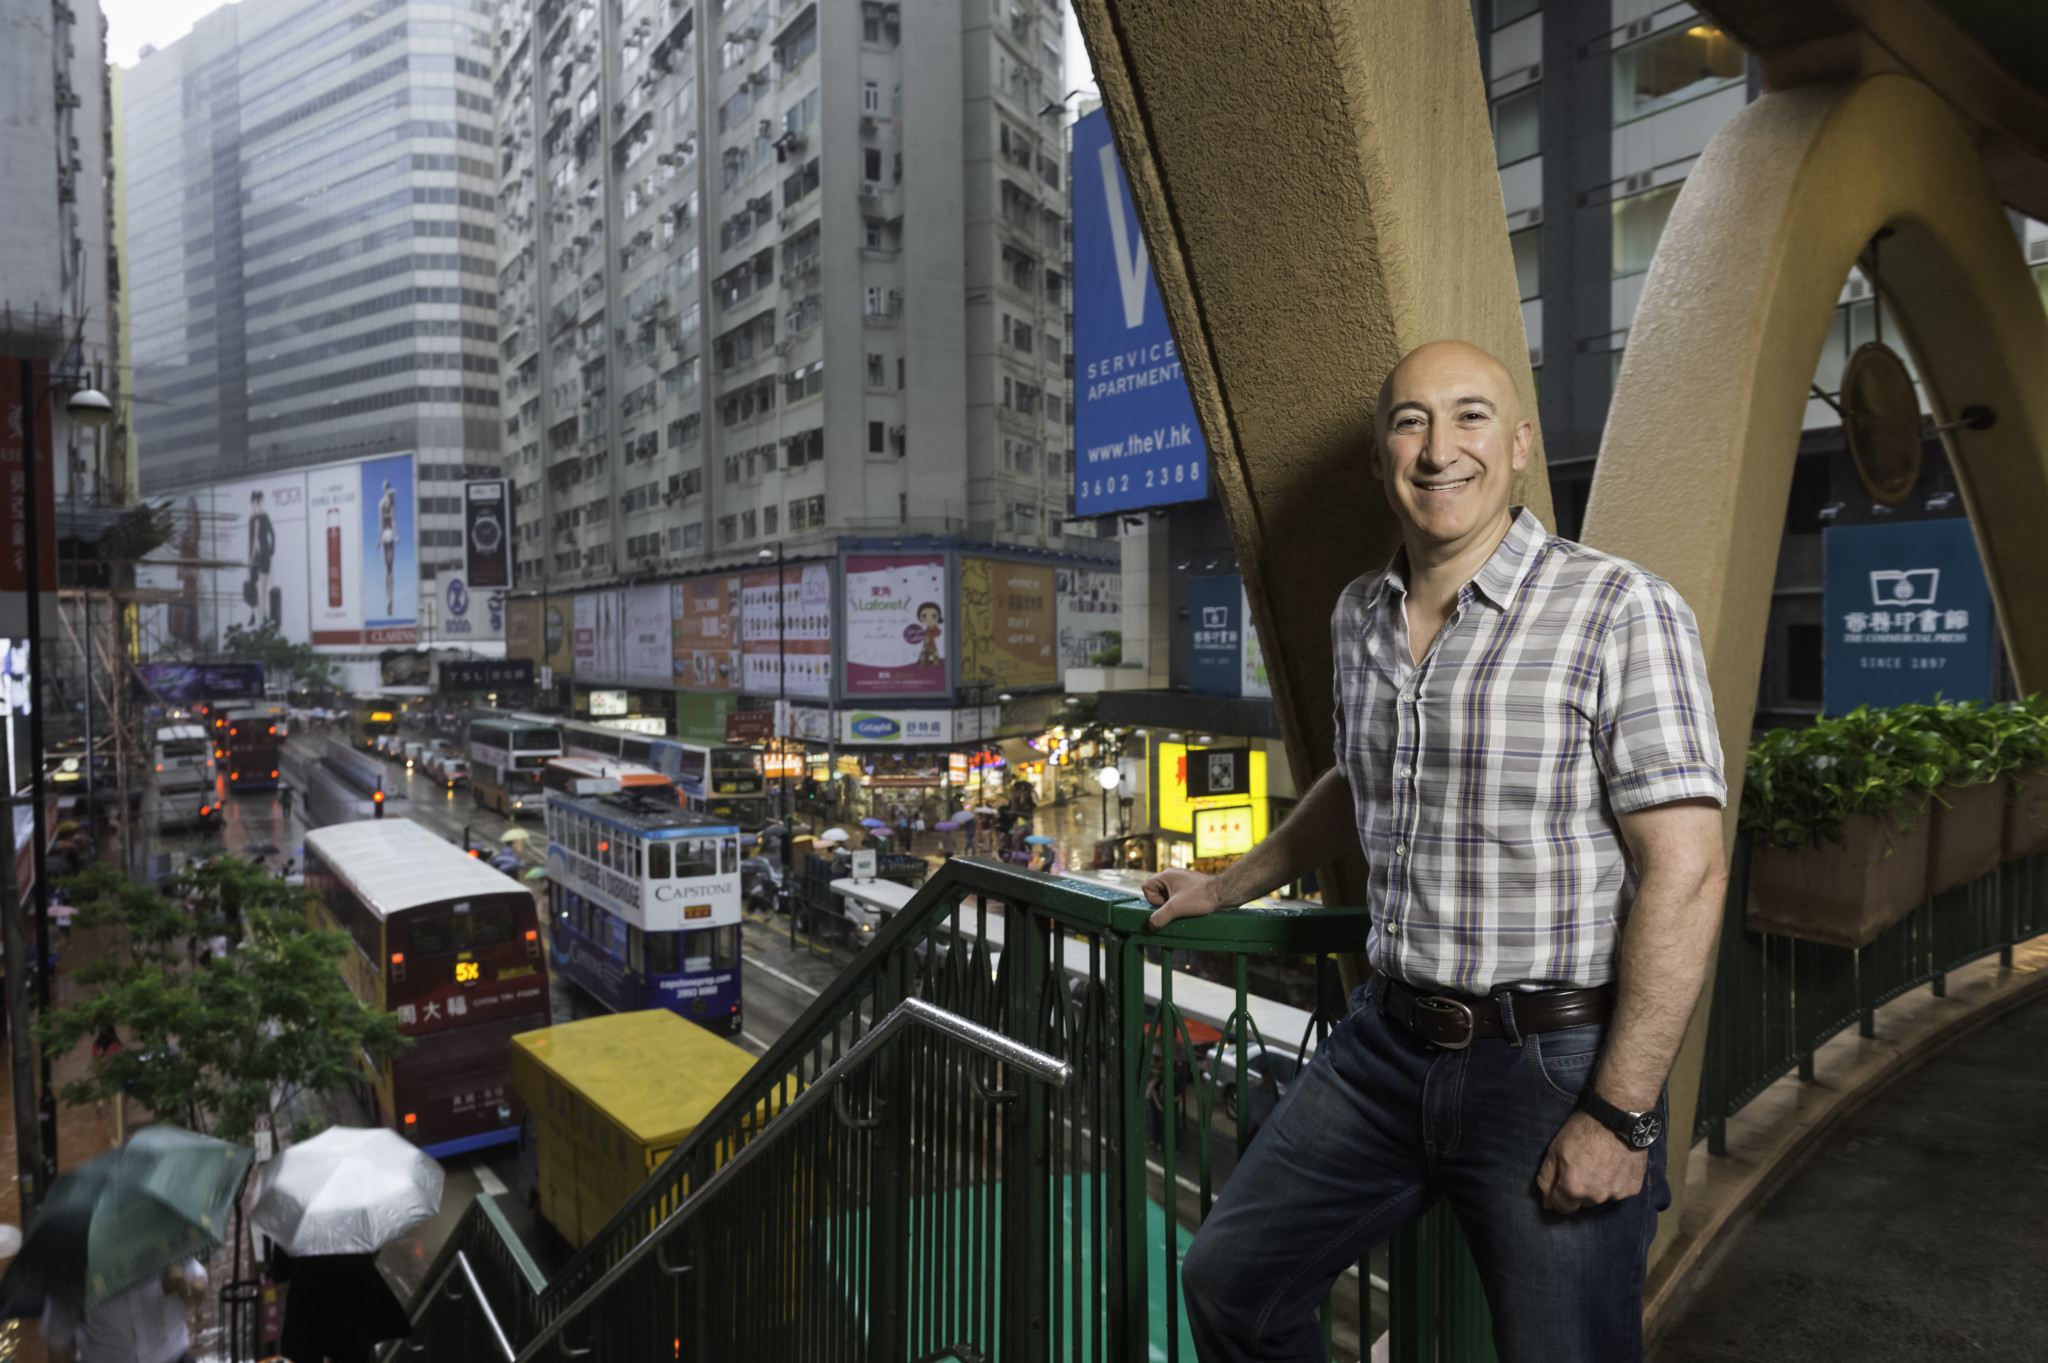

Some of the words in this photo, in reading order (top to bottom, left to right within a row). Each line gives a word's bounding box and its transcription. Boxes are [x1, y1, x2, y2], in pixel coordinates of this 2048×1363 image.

[1087, 362, 1184, 402] APARTMENT
[1087, 424, 1192, 464] www.theV.hk
[1081, 474, 1129, 498] 3602
[1145, 462, 1199, 488] 2388
[858, 599, 903, 611] Laforet
[1843, 608, 1969, 633] 商務印書館
[371, 631, 416, 642] CLARINS
[1866, 633, 1932, 643] COMMERCIAL
[1933, 633, 1967, 643] PRESS
[1860, 657, 1902, 668] SINCE
[1911, 657, 1947, 668] 1897
[655, 882, 734, 902] CAPSTONE
[456, 962, 479, 982] 5X
[397, 995, 467, 1025] 周大福
